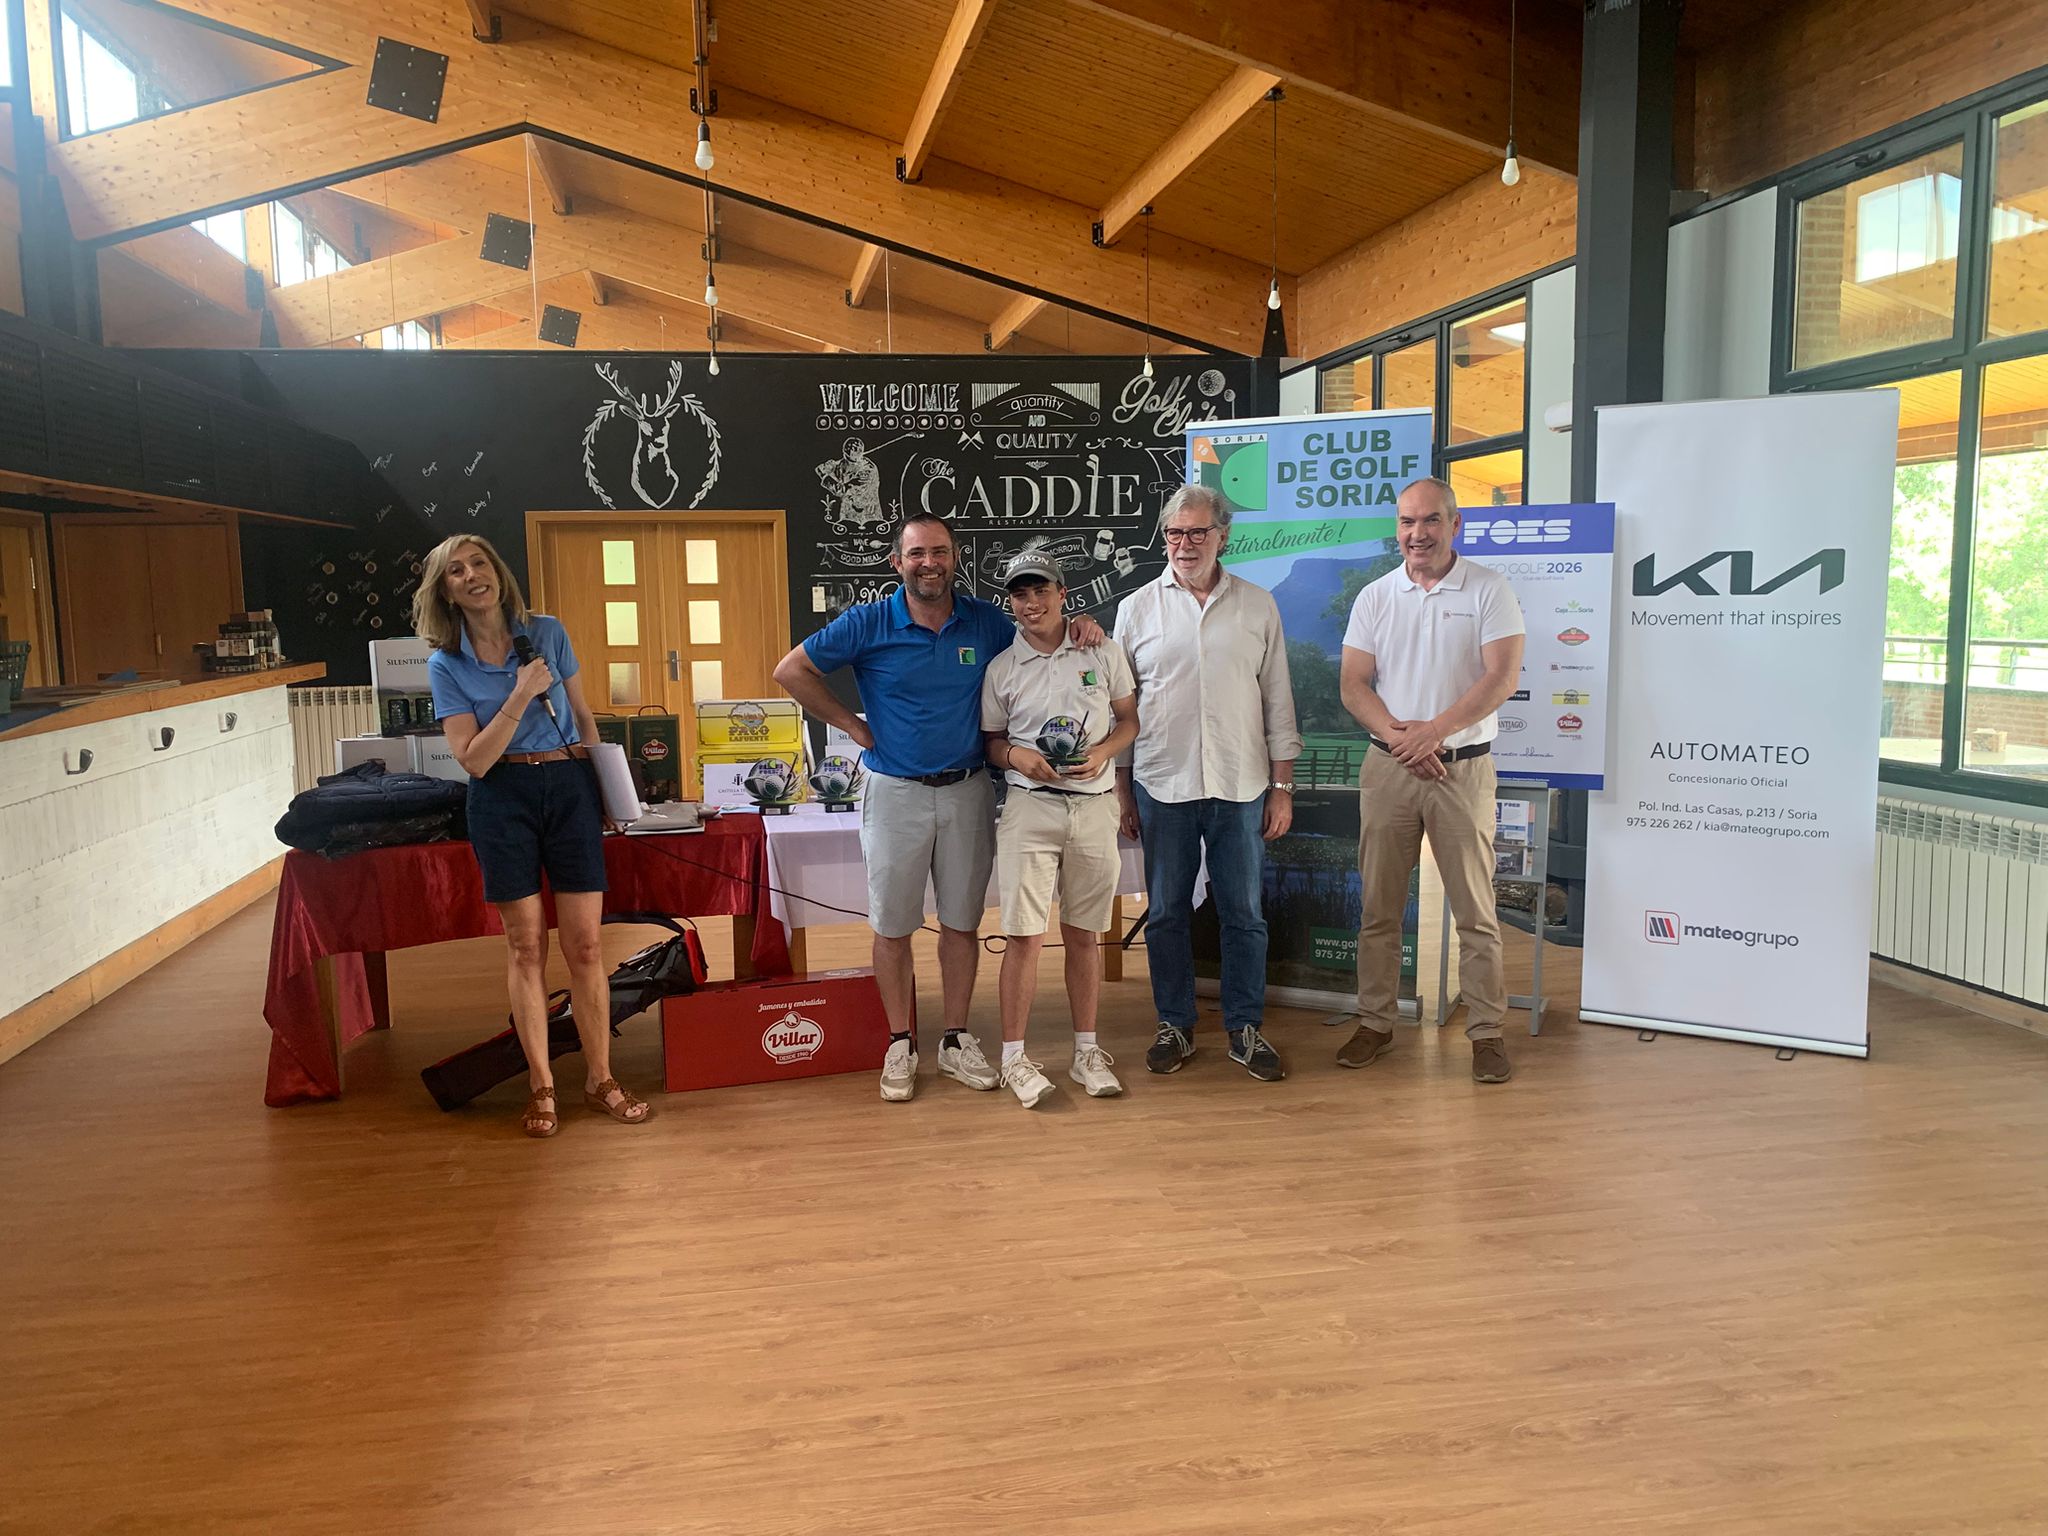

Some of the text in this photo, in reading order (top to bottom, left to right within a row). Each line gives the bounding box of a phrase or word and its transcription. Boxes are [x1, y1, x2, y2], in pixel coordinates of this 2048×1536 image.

[819, 382, 960, 412] WELCOME
[1010, 395, 1064, 411] quantity
[1112, 374, 1191, 423] Golf
[1028, 414, 1046, 427] AND
[1153, 401, 1218, 437] Clb
[996, 432, 1078, 449] QUALITY
[1213, 434, 1265, 444] SORIA
[1303, 429, 1392, 456] CLUB
[920, 457, 954, 478] The
[1277, 455, 1419, 484] DE GOLF
[920, 473, 1143, 519] CADDIE
[1295, 482, 1397, 509] SORIA
[988, 518, 1065, 526] RESTAURANT
[1464, 519, 1571, 545] FOES
[1222, 522, 1347, 556] aturalmente!
[840, 553, 882, 564] GOOD MEAL
[1546, 561, 1583, 574] 2026
[1632, 548, 1846, 597] KIA
[1631, 610, 1842, 629] Movement that inspires
[728, 725, 770, 736] PACO
[1650, 742, 1810, 765] AUTOMATEO
[1668, 773, 1788, 788] Concesionario Oficial
[1638, 801, 1818, 821] Pol. Ind. Las Casas, p.213 / Soria
[1626, 817, 1830, 839] 975 226 262 / kia@mateogrupo.com
[1684, 924, 1799, 949] mateogrupo
[1314, 948, 1334, 959] 975
[1335, 950, 1348, 960] 27
[758, 998, 827, 1013] Jamones y embutidos
[768, 1031, 817, 1048] Villar
[779, 1053, 796, 1061] DESDE
